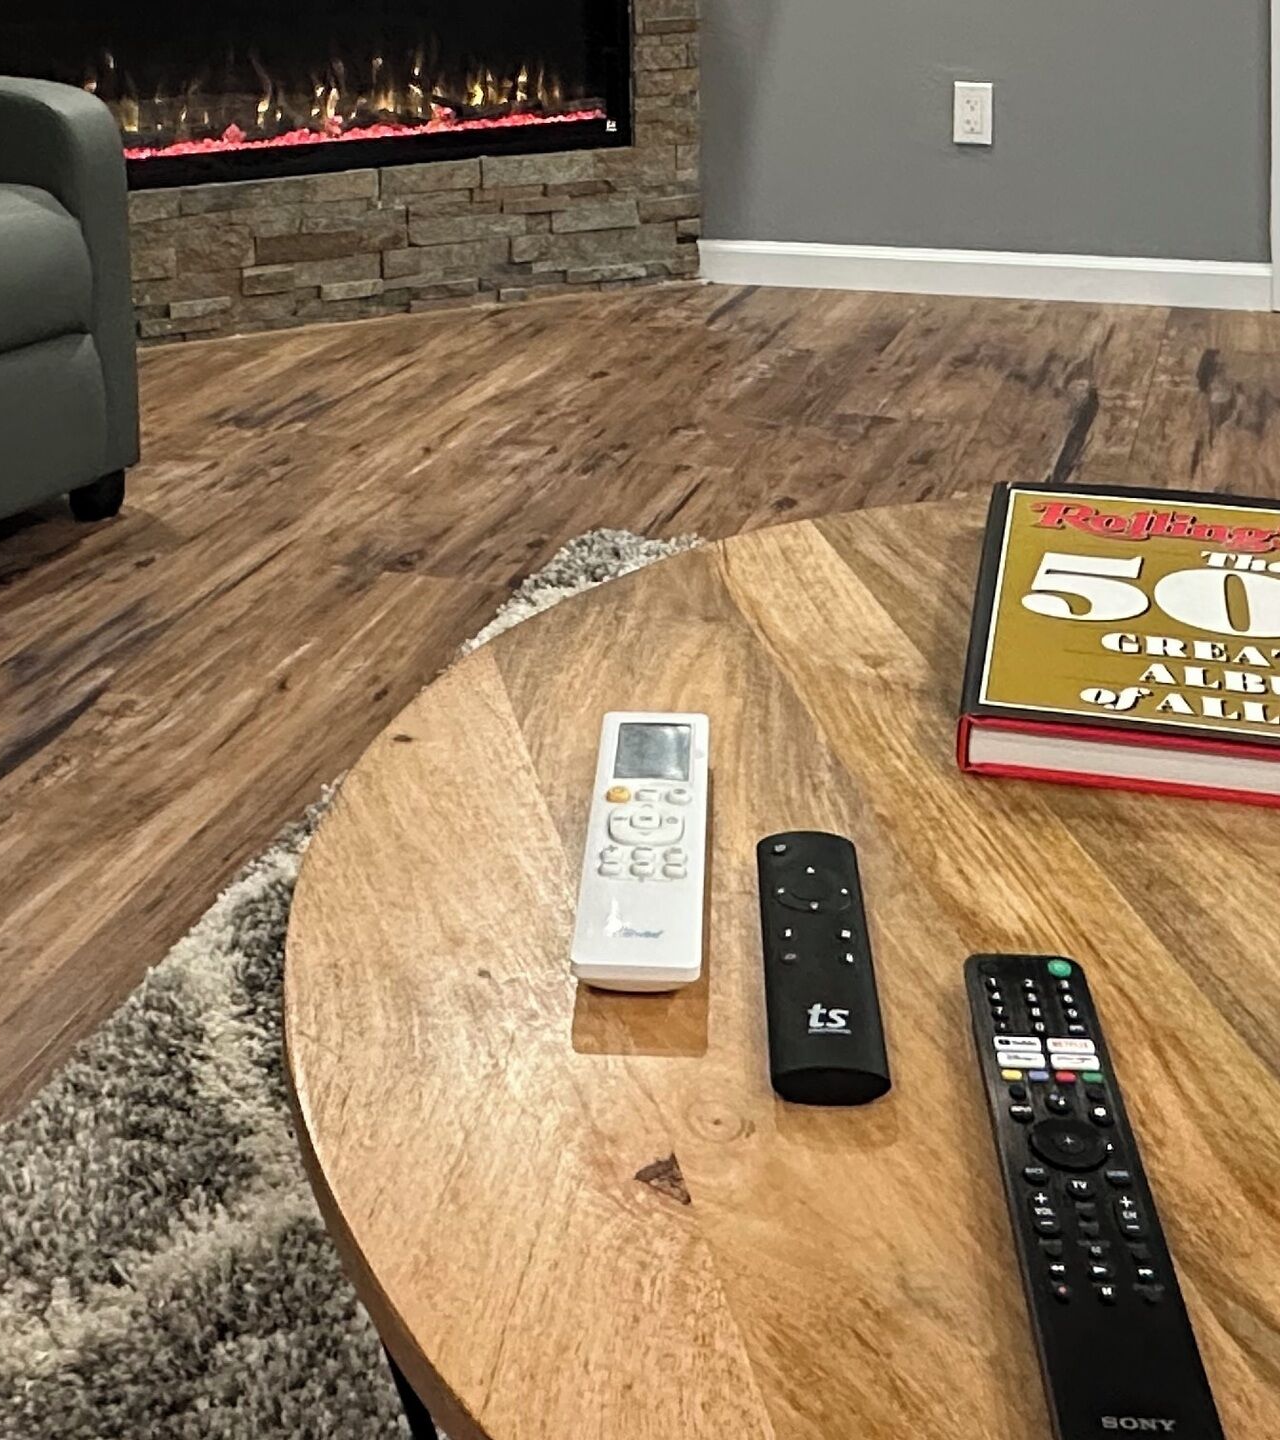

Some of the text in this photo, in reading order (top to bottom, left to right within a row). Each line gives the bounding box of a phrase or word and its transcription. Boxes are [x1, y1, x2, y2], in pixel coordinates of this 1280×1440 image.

[1079, 684, 1151, 713] of
[807, 1003, 850, 1028] ts
[1071, 1179, 1088, 1190] TV
[1101, 1415, 1176, 1432] SONY
